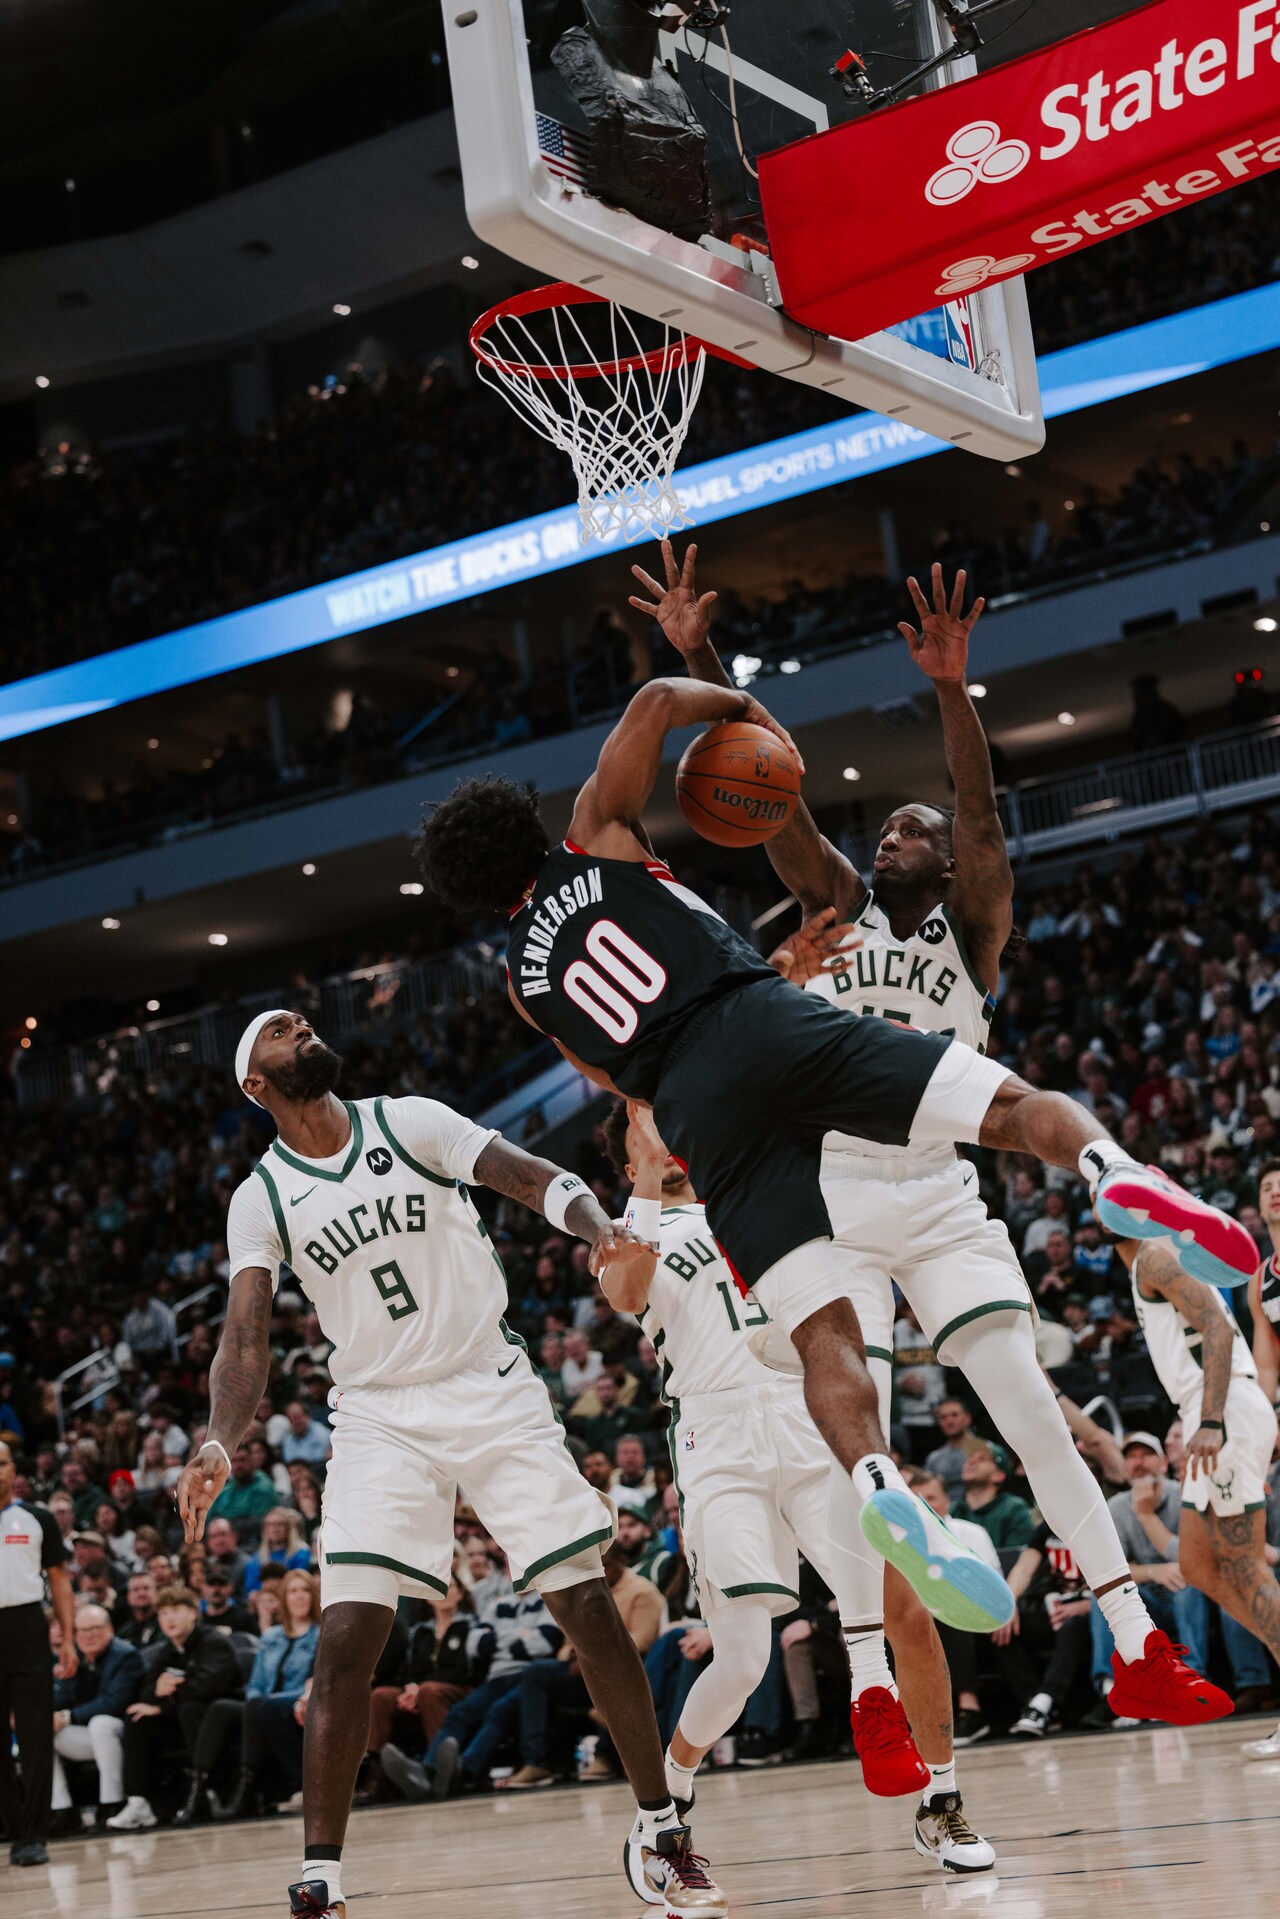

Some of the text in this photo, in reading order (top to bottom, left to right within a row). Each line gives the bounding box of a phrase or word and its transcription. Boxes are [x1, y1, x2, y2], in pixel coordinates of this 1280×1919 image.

[951, 339, 967, 362] NBA
[327, 572, 411, 626] WATCH
[411, 557, 460, 600] THE
[459, 530, 541, 586] BUCKS
[541, 519, 579, 560] ON
[738, 442, 836, 494] SPORTS
[713, 785, 788, 820] Wilson
[521, 867, 603, 997] HENDERSON
[563, 918, 667, 1043] 00
[832, 950, 957, 1006] BUCKS
[304, 1195, 425, 1275] BUCKS
[370, 1259, 419, 1321] 9
